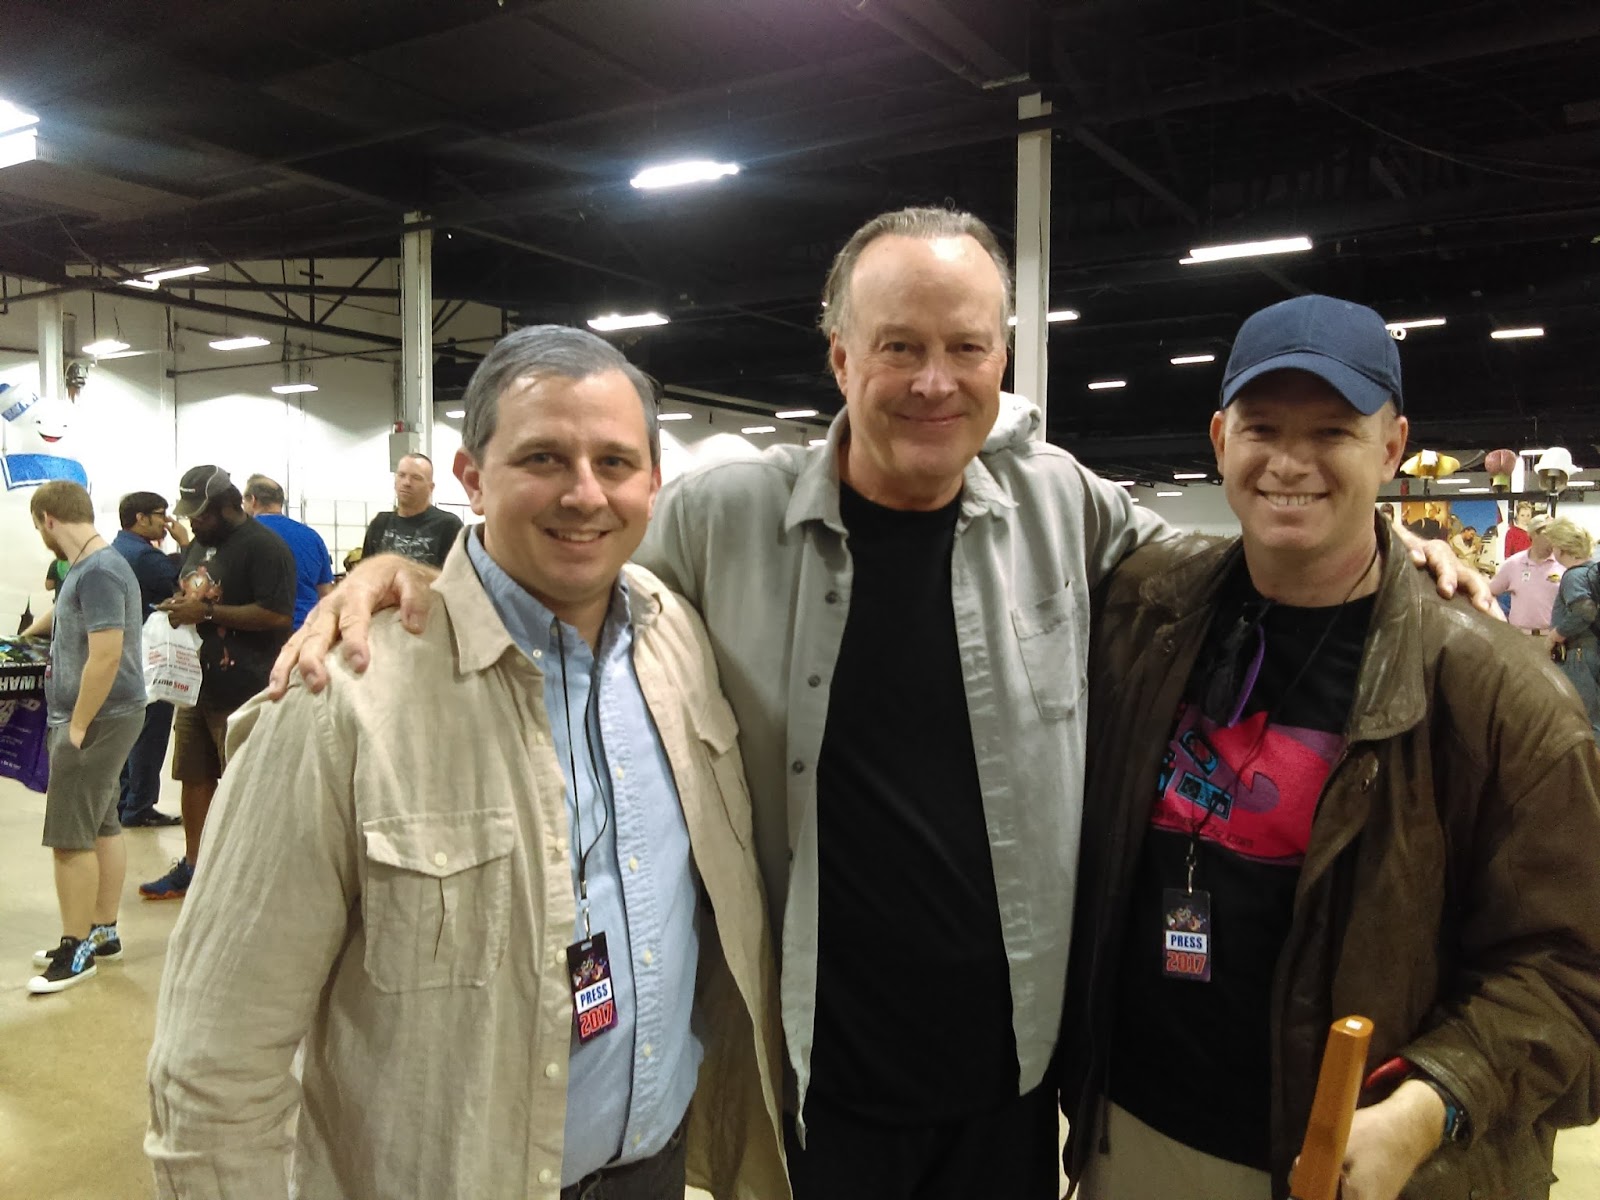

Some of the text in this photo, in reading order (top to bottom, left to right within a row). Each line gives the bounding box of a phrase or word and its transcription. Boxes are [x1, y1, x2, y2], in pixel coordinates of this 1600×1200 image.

[1171, 934, 1202, 949] PRESS
[1166, 950, 1207, 974] 2017
[580, 983, 608, 1008] PRESS
[580, 1000, 613, 1037] 2017
